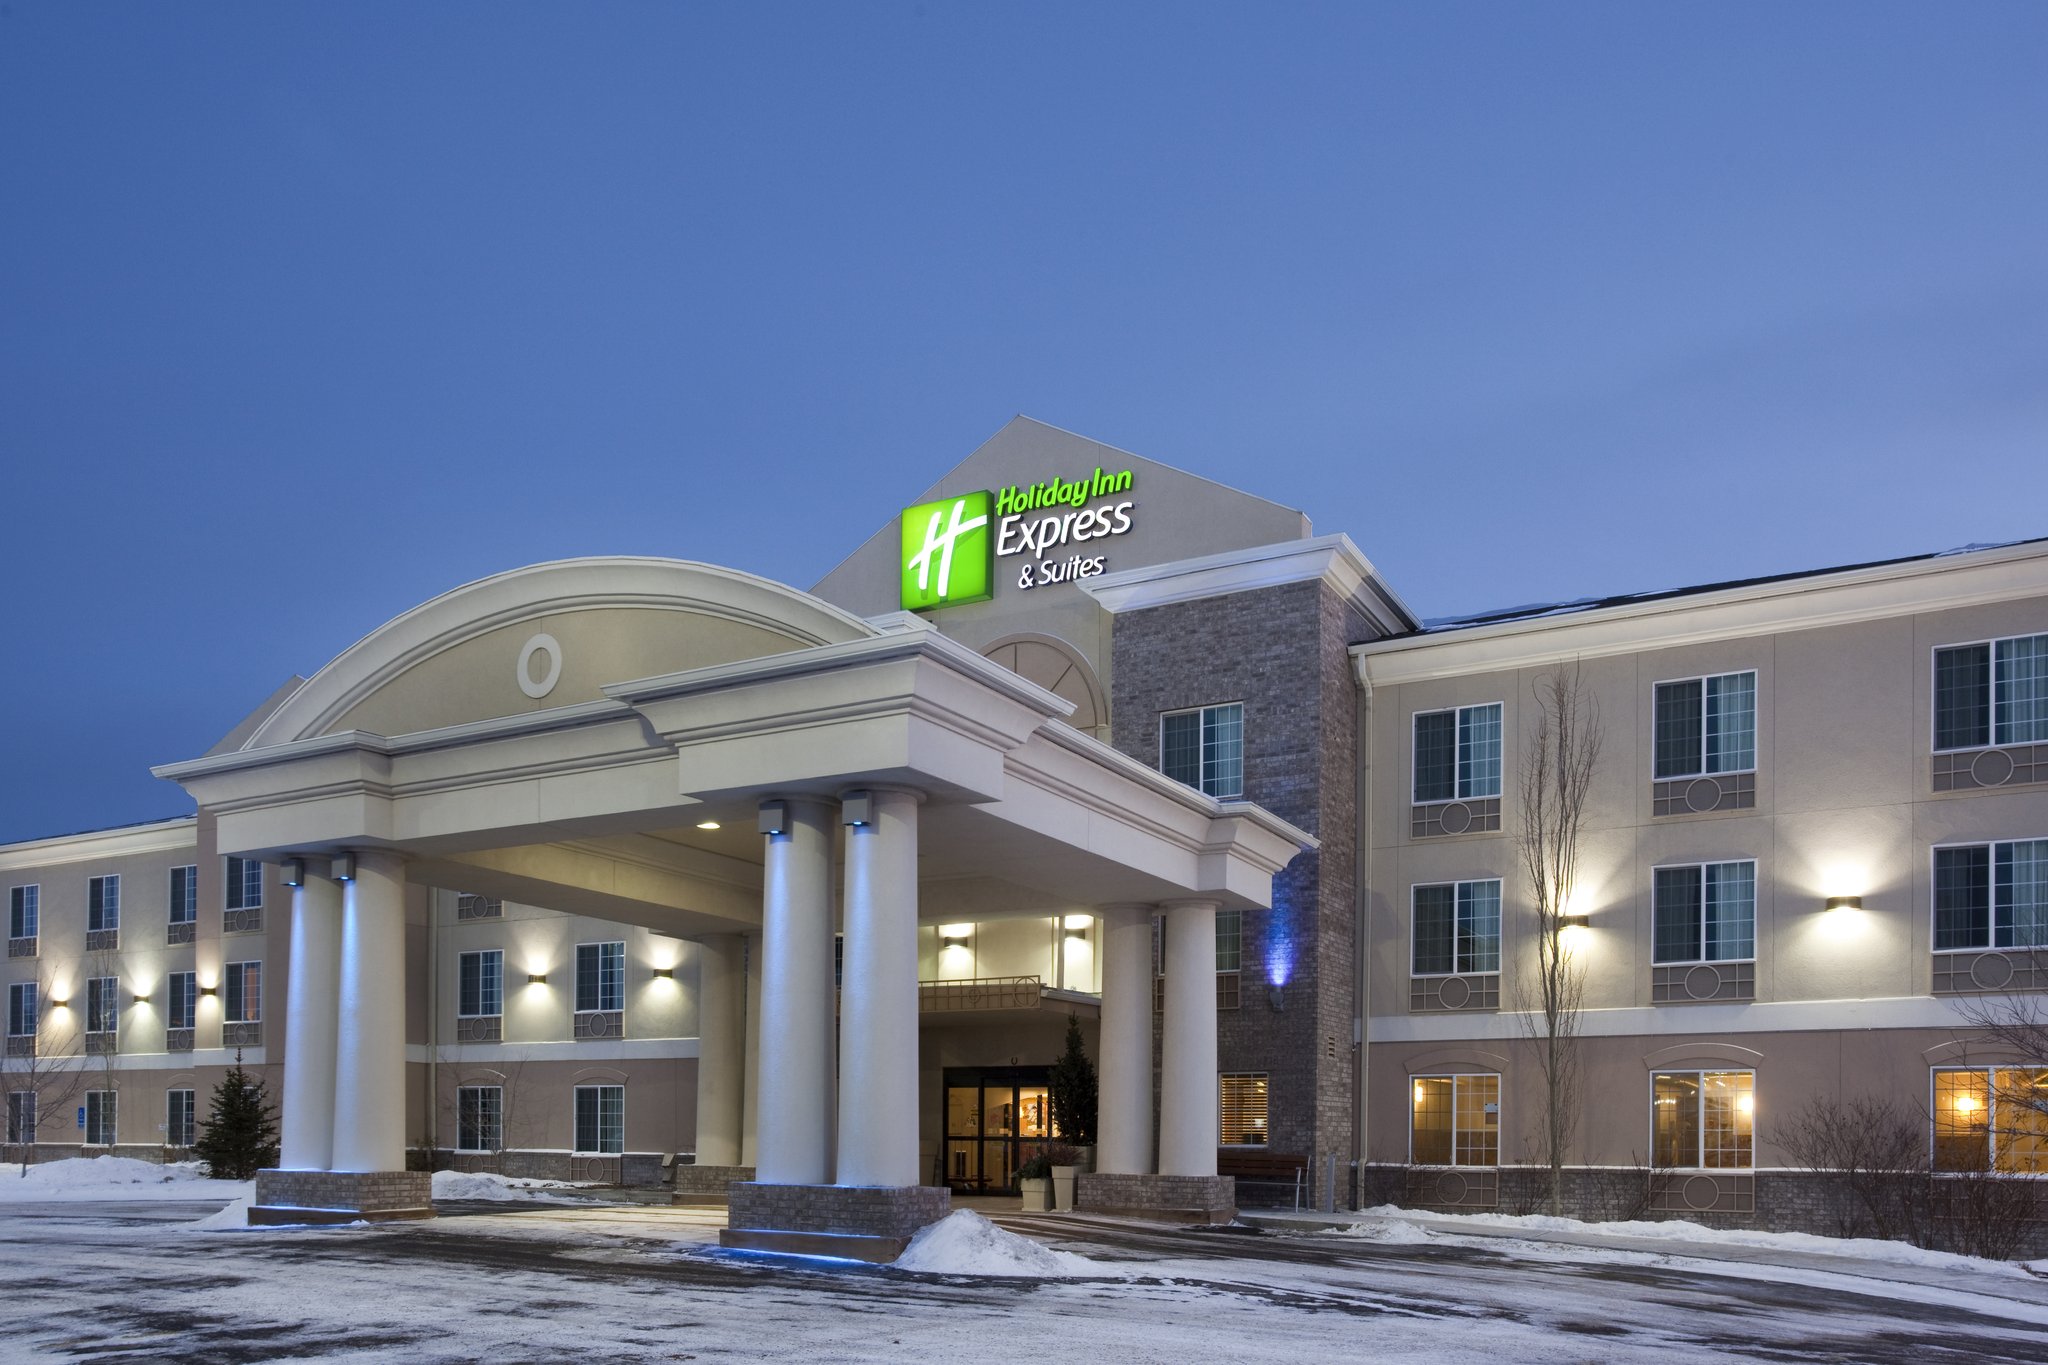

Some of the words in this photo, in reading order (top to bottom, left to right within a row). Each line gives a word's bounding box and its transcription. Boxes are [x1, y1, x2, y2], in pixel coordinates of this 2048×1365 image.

[996, 477, 1090, 516] Holiday
[1091, 467, 1132, 497] Inn
[996, 502, 1133, 559] Express
[1018, 564, 1034, 589] &
[1038, 555, 1105, 585] Suites
